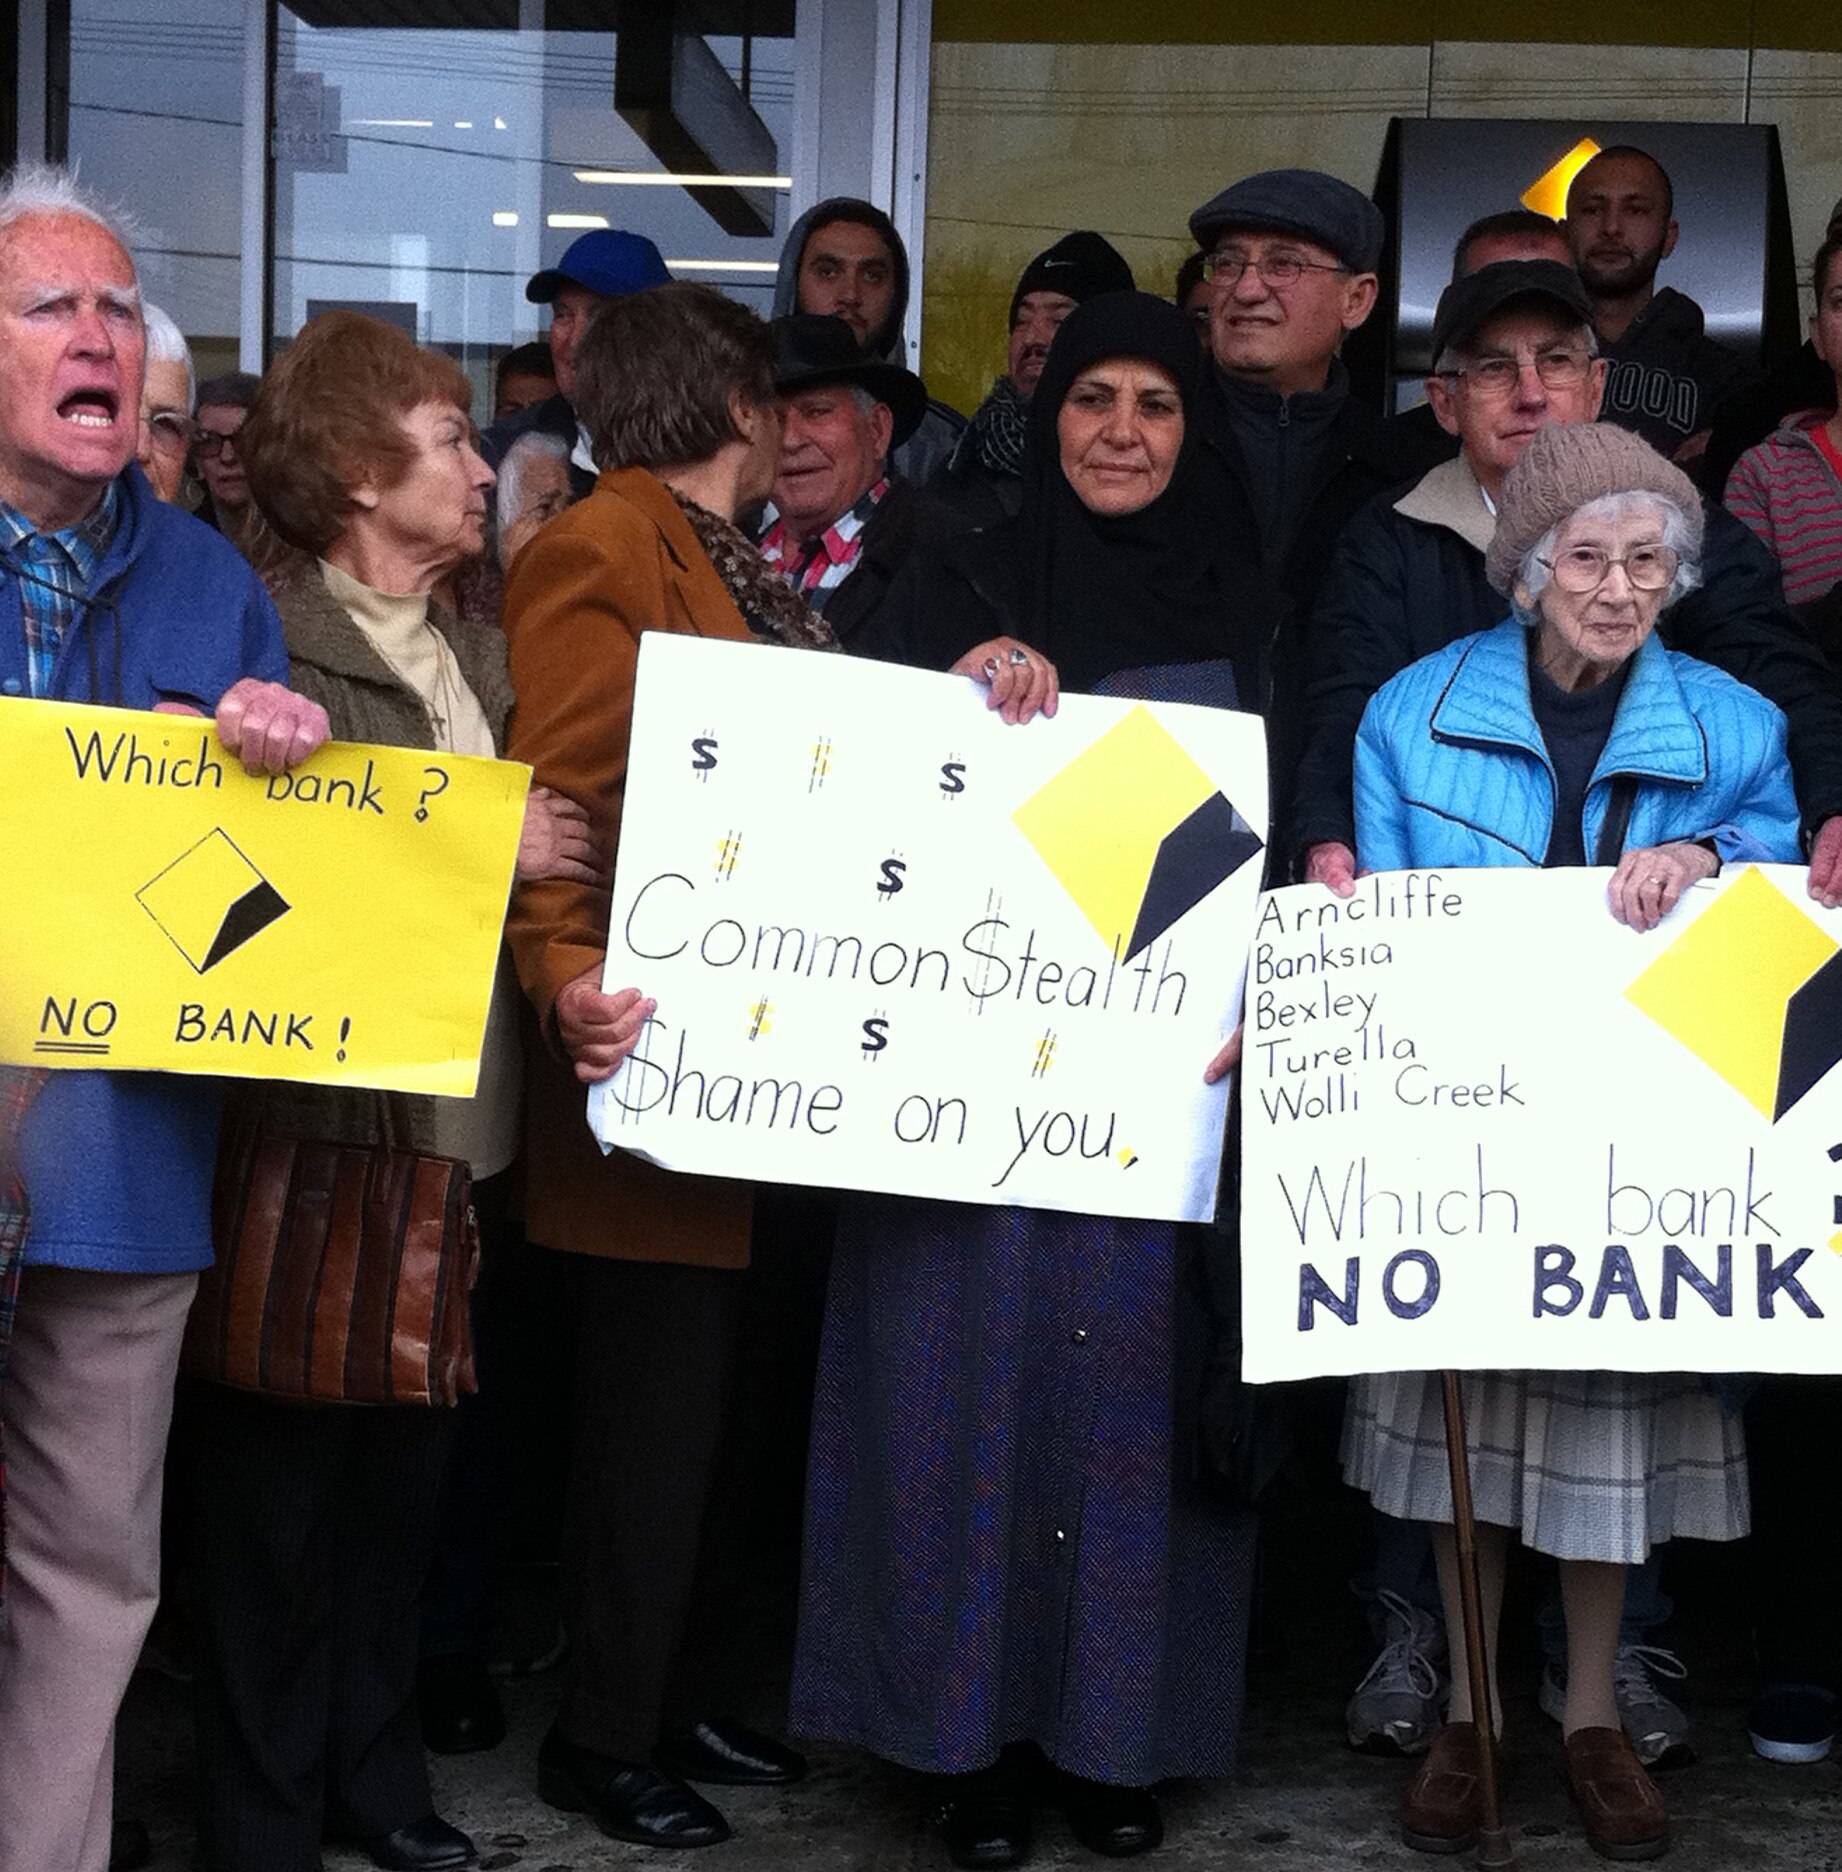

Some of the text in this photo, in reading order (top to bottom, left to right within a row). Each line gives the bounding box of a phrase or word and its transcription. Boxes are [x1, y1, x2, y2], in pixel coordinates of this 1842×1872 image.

[1600, 358, 1698, 434] OOD
[66, 726, 450, 823] Which bank ?
[1255, 874, 1463, 940] Arncliffe
[1255, 933, 1394, 985] Banksia
[39, 995, 352, 1063] NO BANK !
[1256, 980, 1377, 1033] Bexley
[1256, 1024, 1416, 1077] Turella
[893, 1093, 968, 1145] on
[1260, 1063, 1526, 1125] Wolli Creek
[1277, 1142, 1518, 1246] Which
[1607, 1142, 1781, 1237] bank
[1297, 1243, 1825, 1332] NO BANK
